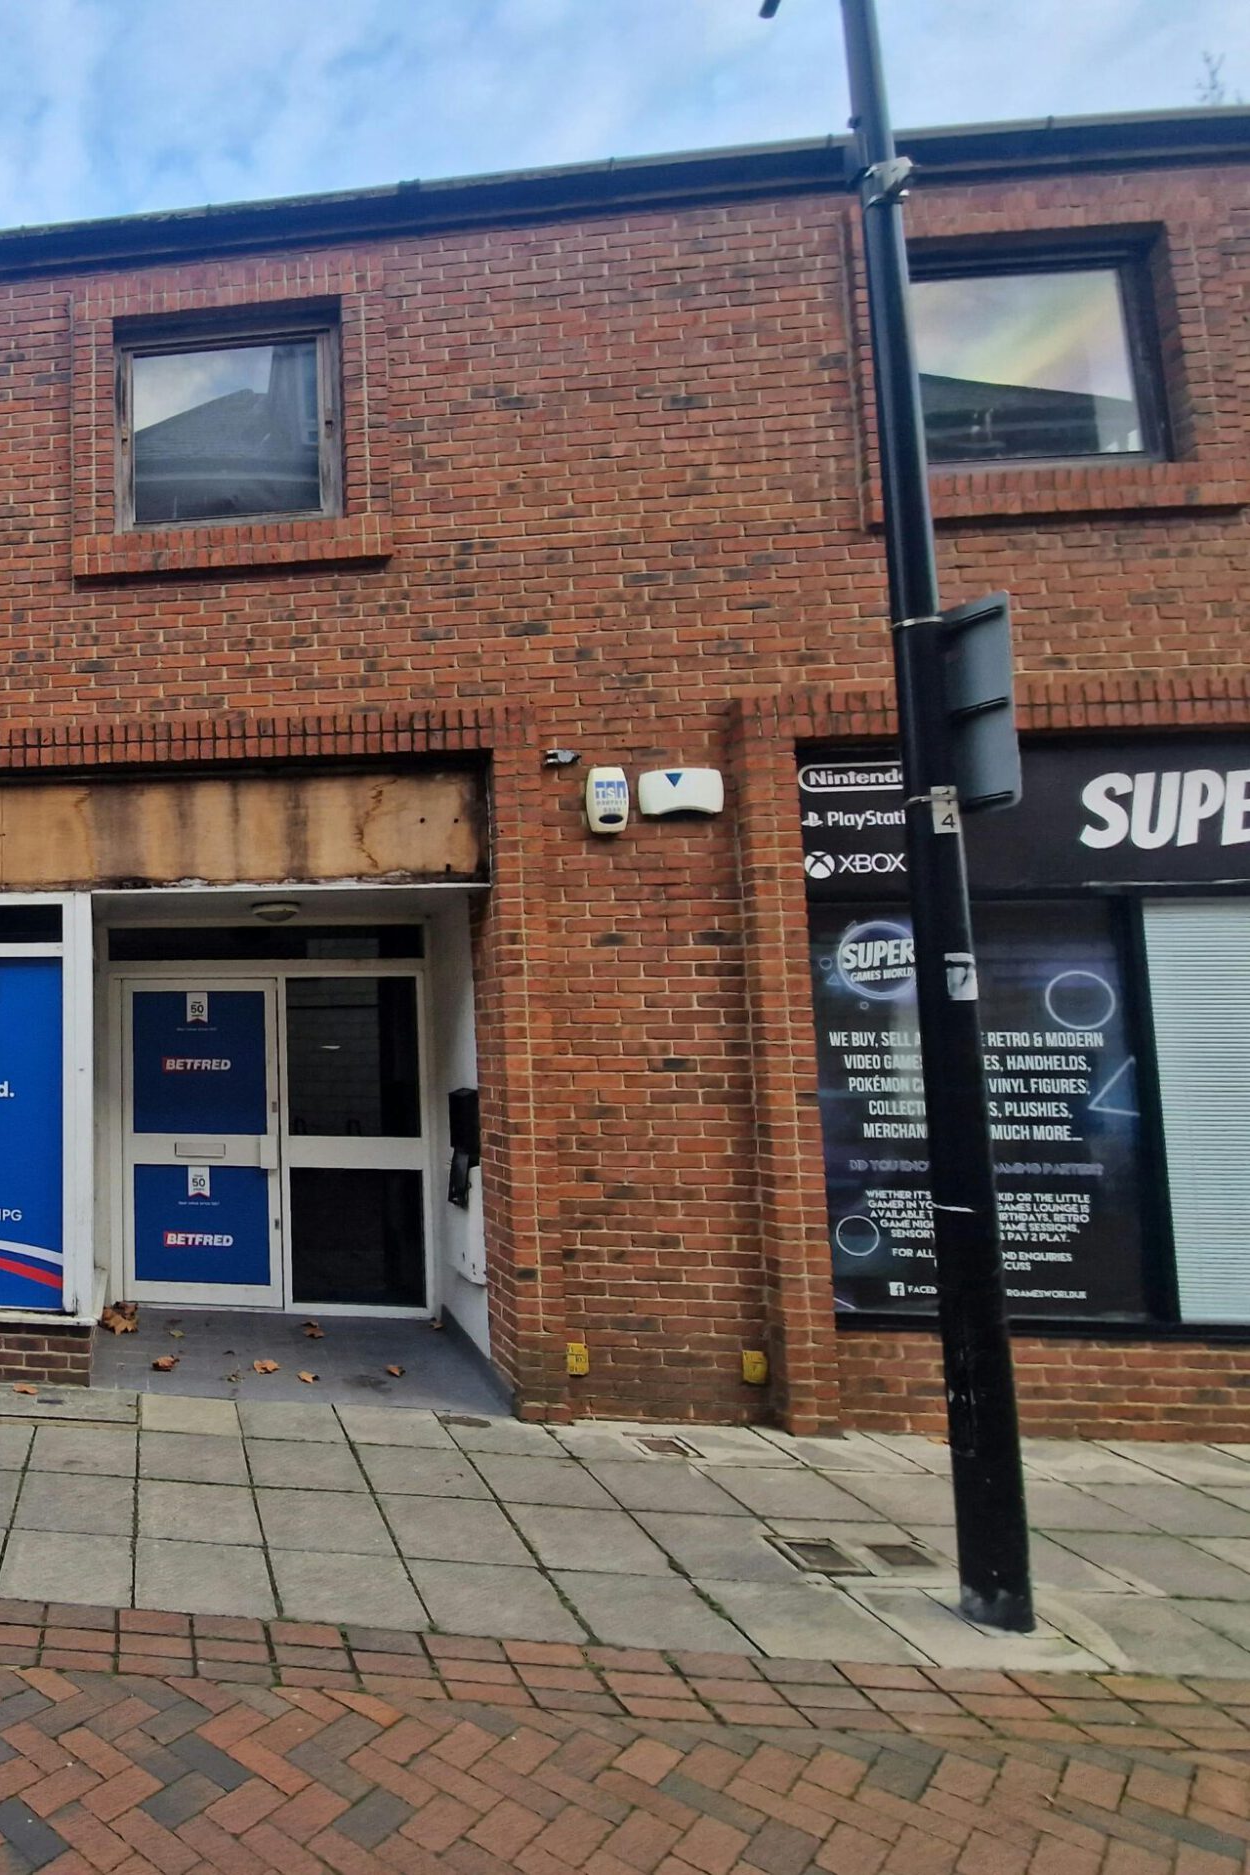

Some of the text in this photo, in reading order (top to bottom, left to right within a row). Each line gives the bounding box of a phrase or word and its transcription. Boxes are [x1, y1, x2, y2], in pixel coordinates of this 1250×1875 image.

[809, 768, 903, 786] Nintend
[1079, 769, 1250, 850] SUPE
[838, 853, 907, 873] XBOX
[841, 938, 916, 970] SUPER
[851, 967, 915, 983] GAMES WORLD
[190, 1004, 204, 1014] 50
[829, 1032, 849, 1047] WE
[852, 1032, 879, 1048] BUY,
[881, 1032, 912, 1047] SELL
[987, 1032, 1030, 1048] RETRO
[1033, 1032, 1043, 1047] &
[1045, 1032, 1105, 1048] MODERN
[165, 1059, 232, 1071] BETFRED
[844, 1054, 881, 1070] VIDEO
[1006, 1055, 1091, 1072] HANDHELDS,
[848, 1074, 911, 1093] POKÉMON
[988, 1078, 1029, 1094] VINYL
[1030, 1078, 1091, 1095] FIGURES,
[1004, 1102, 1073, 1119] PLUSHIES,
[990, 1124, 1030, 1141] MUCH
[192, 1178, 206, 1188] 50
[865, 1189, 912, 1200] WHETHER
[997, 1192, 1015, 1202] KID
[1016, 1193, 1032, 1202] OR
[1033, 1193, 1054, 1203] THE
[1056, 1194, 1091, 1204] LITTLE
[868, 1199, 904, 1209] GAMER
[905, 1200, 918, 1209] IN
[1033, 1203, 1079, 1213] LOUNGE
[1080, 1204, 1091, 1214] IS
[870, 1209, 925, 1219] AVAILABLE
[1053, 1213, 1090, 1223] RETRO
[880, 1219, 912, 1229] GAME
[166, 1232, 234, 1247] BETFRED
[1007, 1232, 1030, 1242] PAY
[1030, 1232, 1038, 1242] 2
[892, 1247, 914, 1257] FOR
[916, 1248, 936, 1258] ALL
